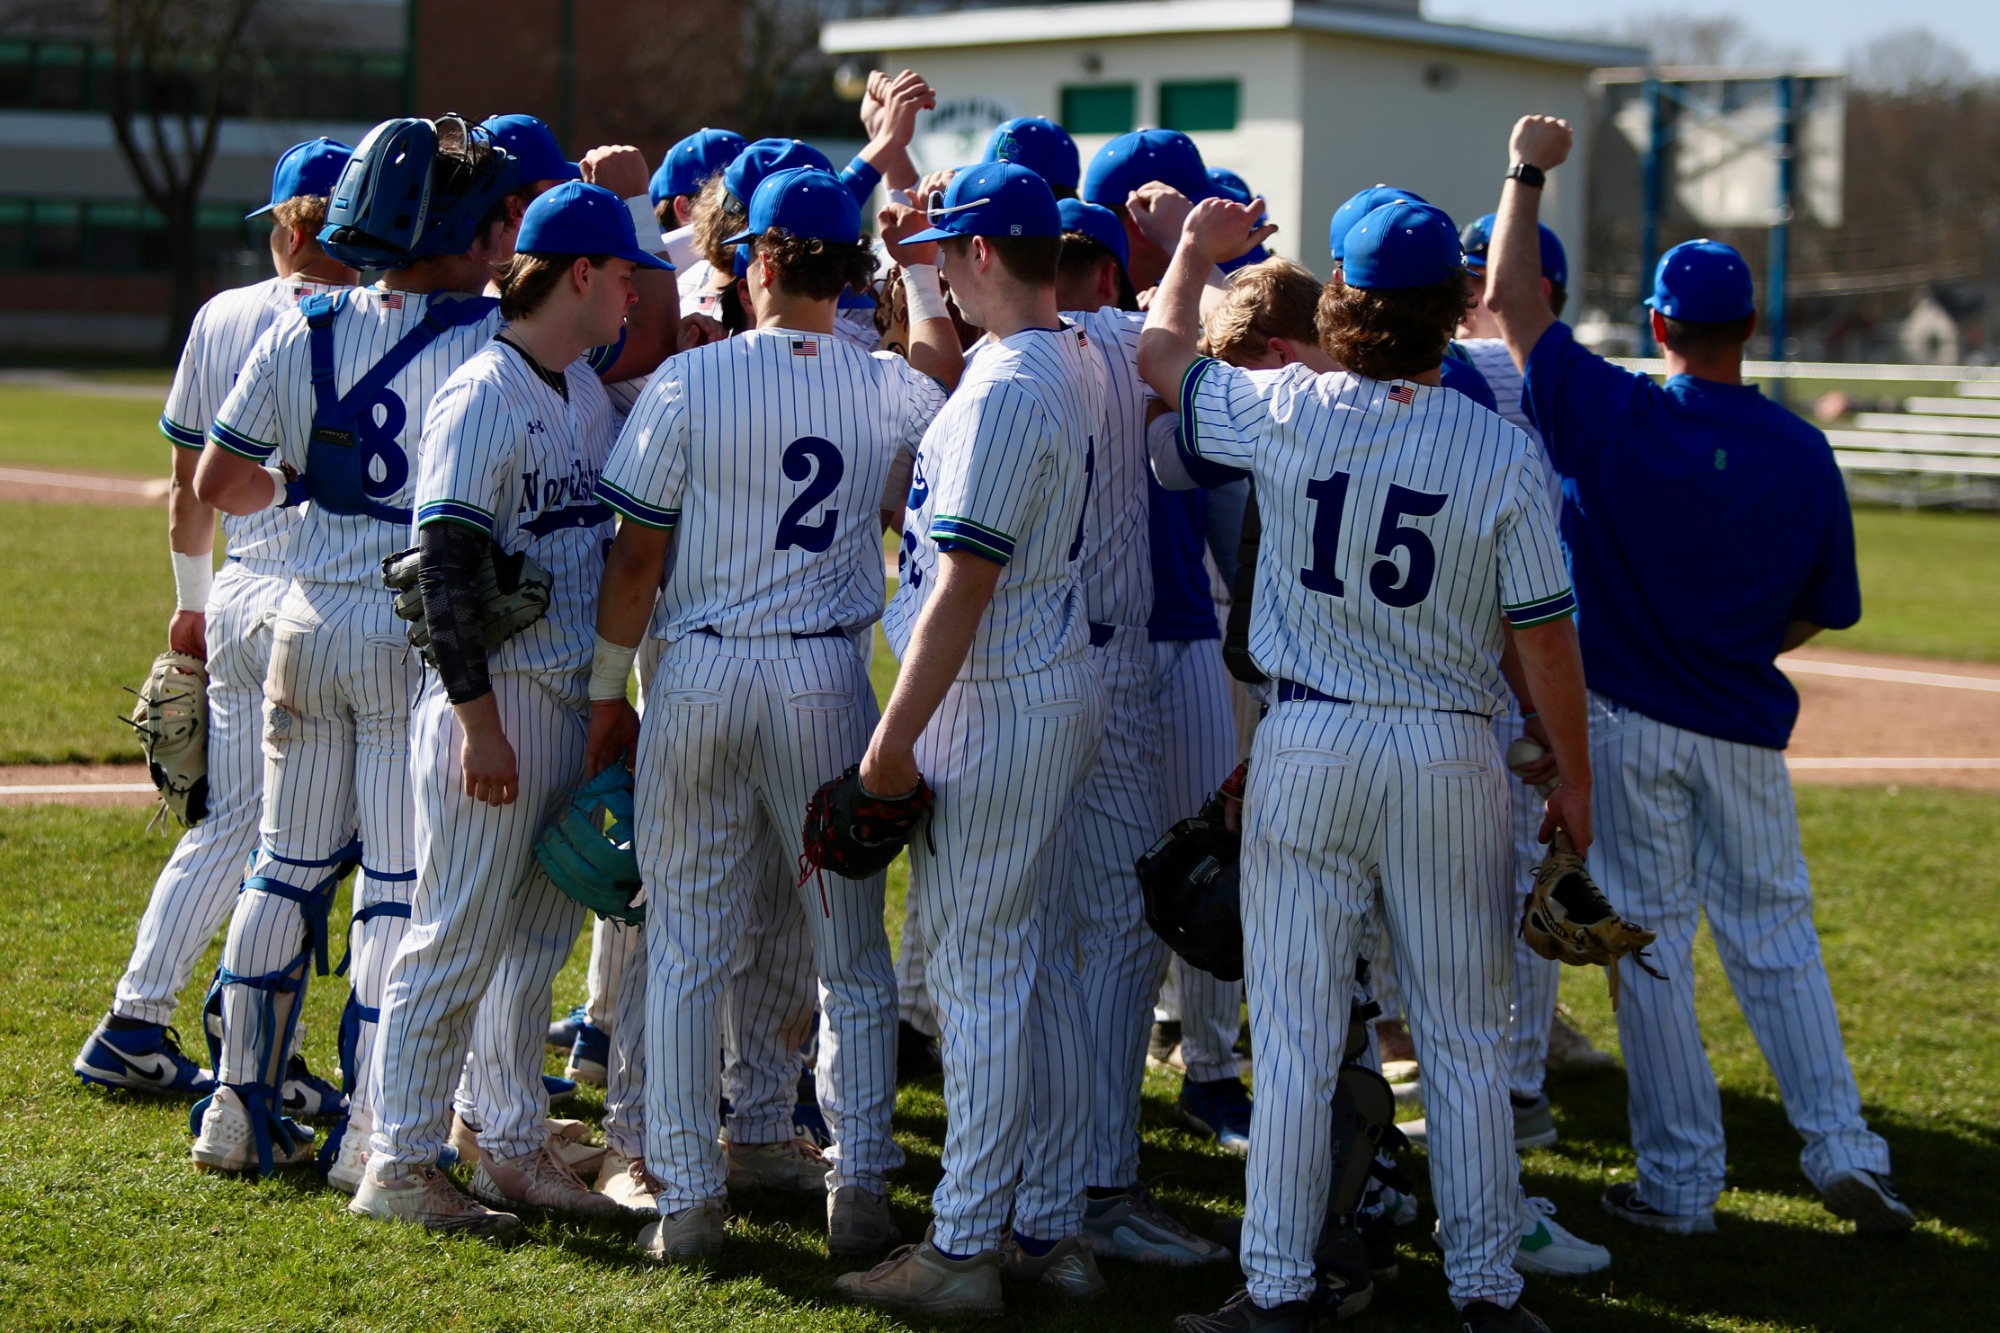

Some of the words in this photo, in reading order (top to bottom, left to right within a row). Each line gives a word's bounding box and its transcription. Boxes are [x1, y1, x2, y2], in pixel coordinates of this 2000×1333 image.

[357, 387, 409, 498] 8
[775, 436, 844, 553] 2
[1300, 471, 1449, 608] 15
